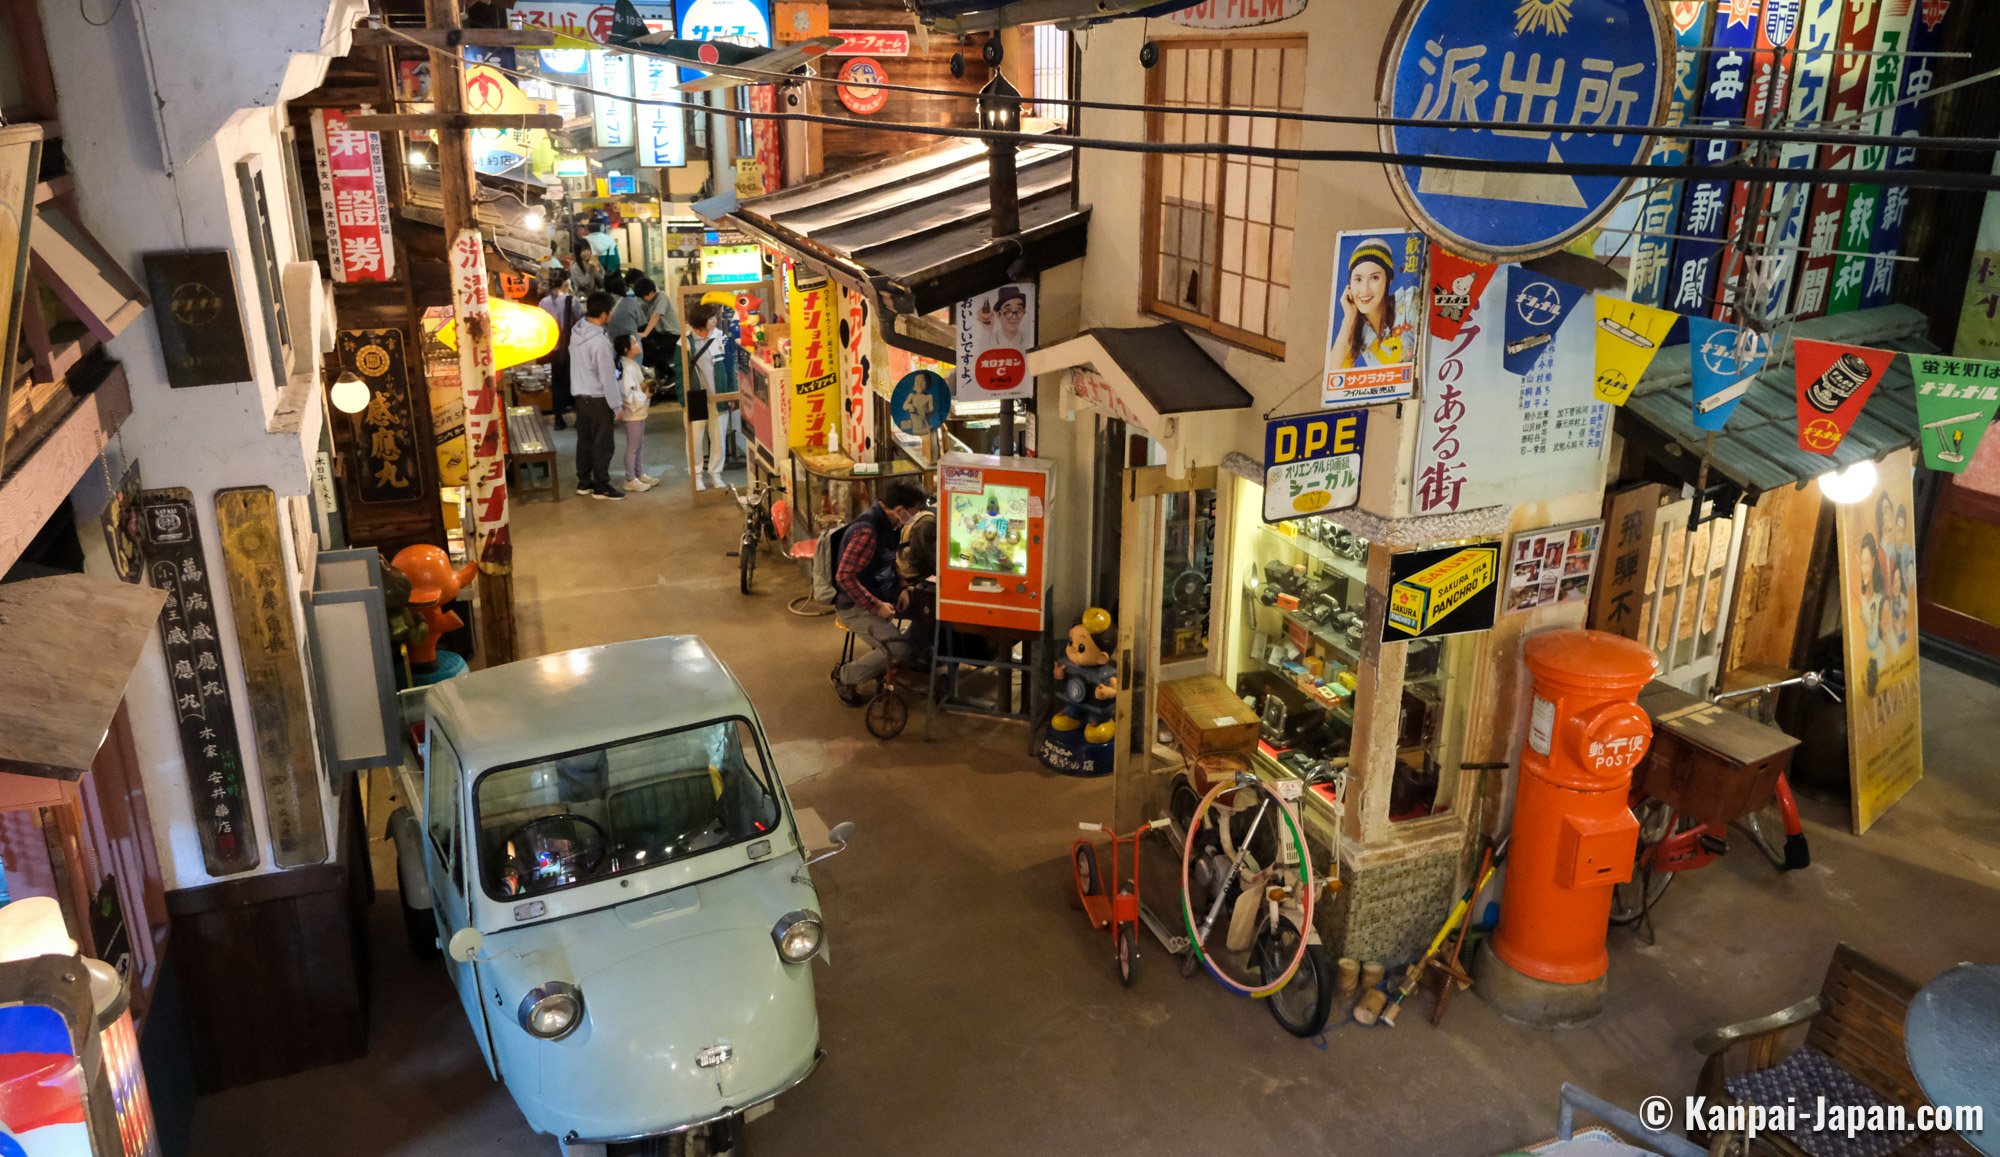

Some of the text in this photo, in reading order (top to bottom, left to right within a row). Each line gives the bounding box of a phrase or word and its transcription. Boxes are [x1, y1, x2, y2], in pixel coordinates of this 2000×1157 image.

[1411, 38, 1645, 147] 派出所
[316, 147, 331, 192] 松本支店
[1633, 49, 1698, 304] 岐阜日日新
[1674, 47, 1745, 309] 毎日新聞
[1866, 57, 1934, 298] 中日新聞
[326, 118, 383, 273] 第一證券
[1515, 292, 1563, 317] ナショナル
[803, 291, 825, 379] ナショナル
[996, 368, 1006, 376] C
[1346, 370, 1403, 387] サクラカラー
[1919, 382, 2000, 401] ナショナル
[1921, 359, 2000, 380] 蛍光灯は
[805, 393, 826, 447] ラジオ
[1416, 299, 1482, 512] ラのある街
[1275, 416, 1361, 464] D.P.E.
[1289, 470, 1357, 498] シーガル
[1418, 552, 1481, 584] SAKURA
[1437, 574, 1470, 598] SAKURA
[1473, 562, 1487, 576] FILM
[1392, 603, 1418, 618] SAKURA
[1432, 579, 1478, 619] PANCHRO
[1482, 571, 1489, 585] F
[1595, 752, 1633, 769] POST
